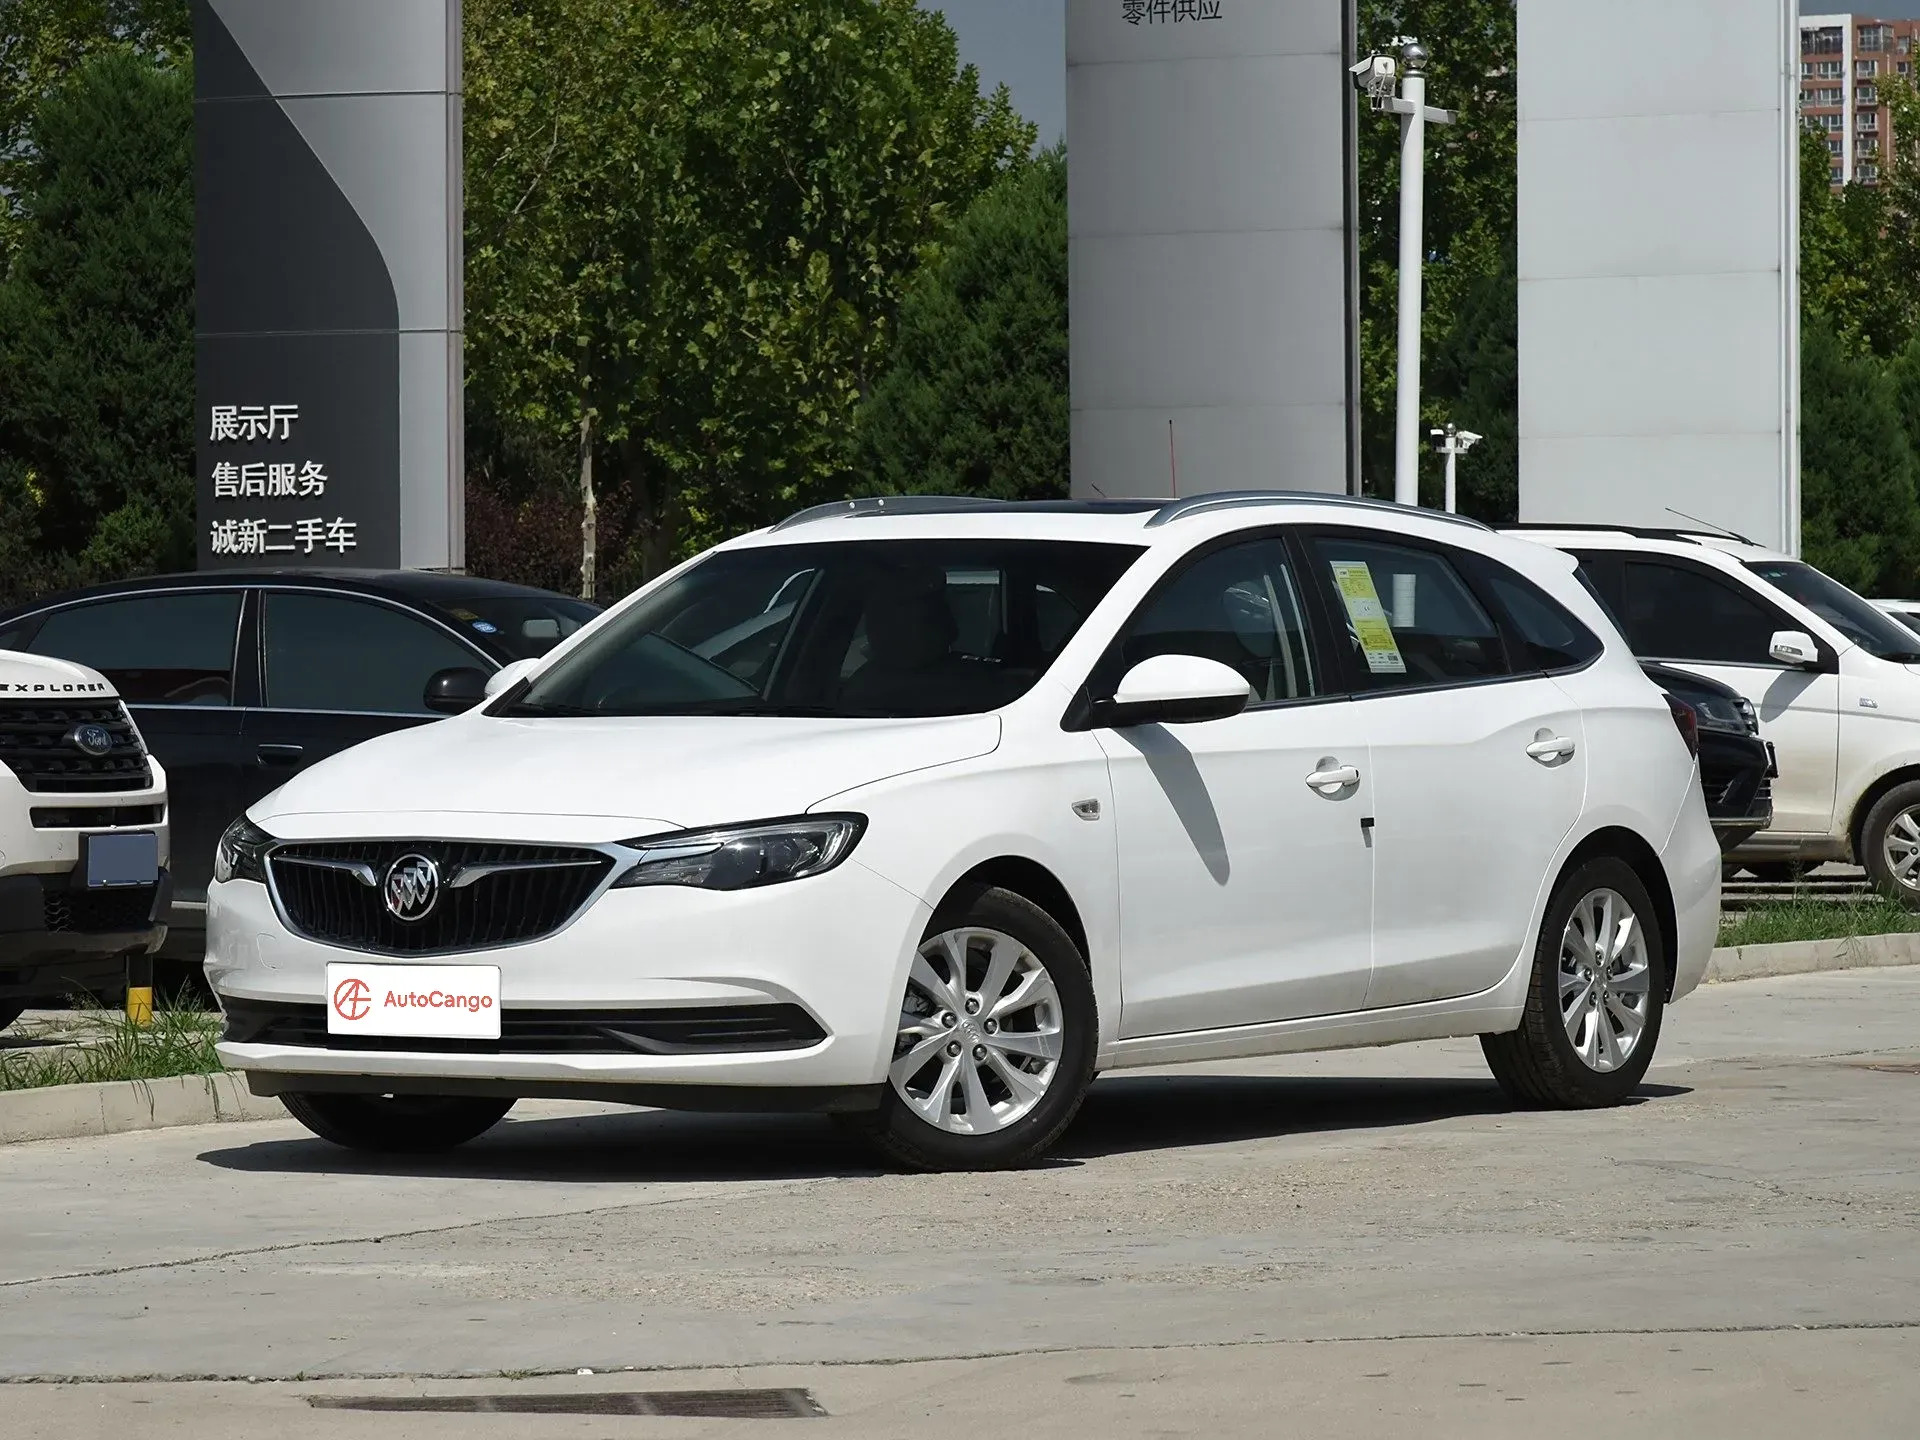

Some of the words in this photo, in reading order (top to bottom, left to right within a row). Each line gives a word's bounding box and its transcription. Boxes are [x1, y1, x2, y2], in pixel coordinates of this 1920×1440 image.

[210, 405, 299, 441] 展示厅
[211, 460, 328, 497] 售后服务
[210, 517, 357, 554] 诚新二手车
[0, 683, 105, 692] EXPLORER
[87, 729, 107, 746] Ford
